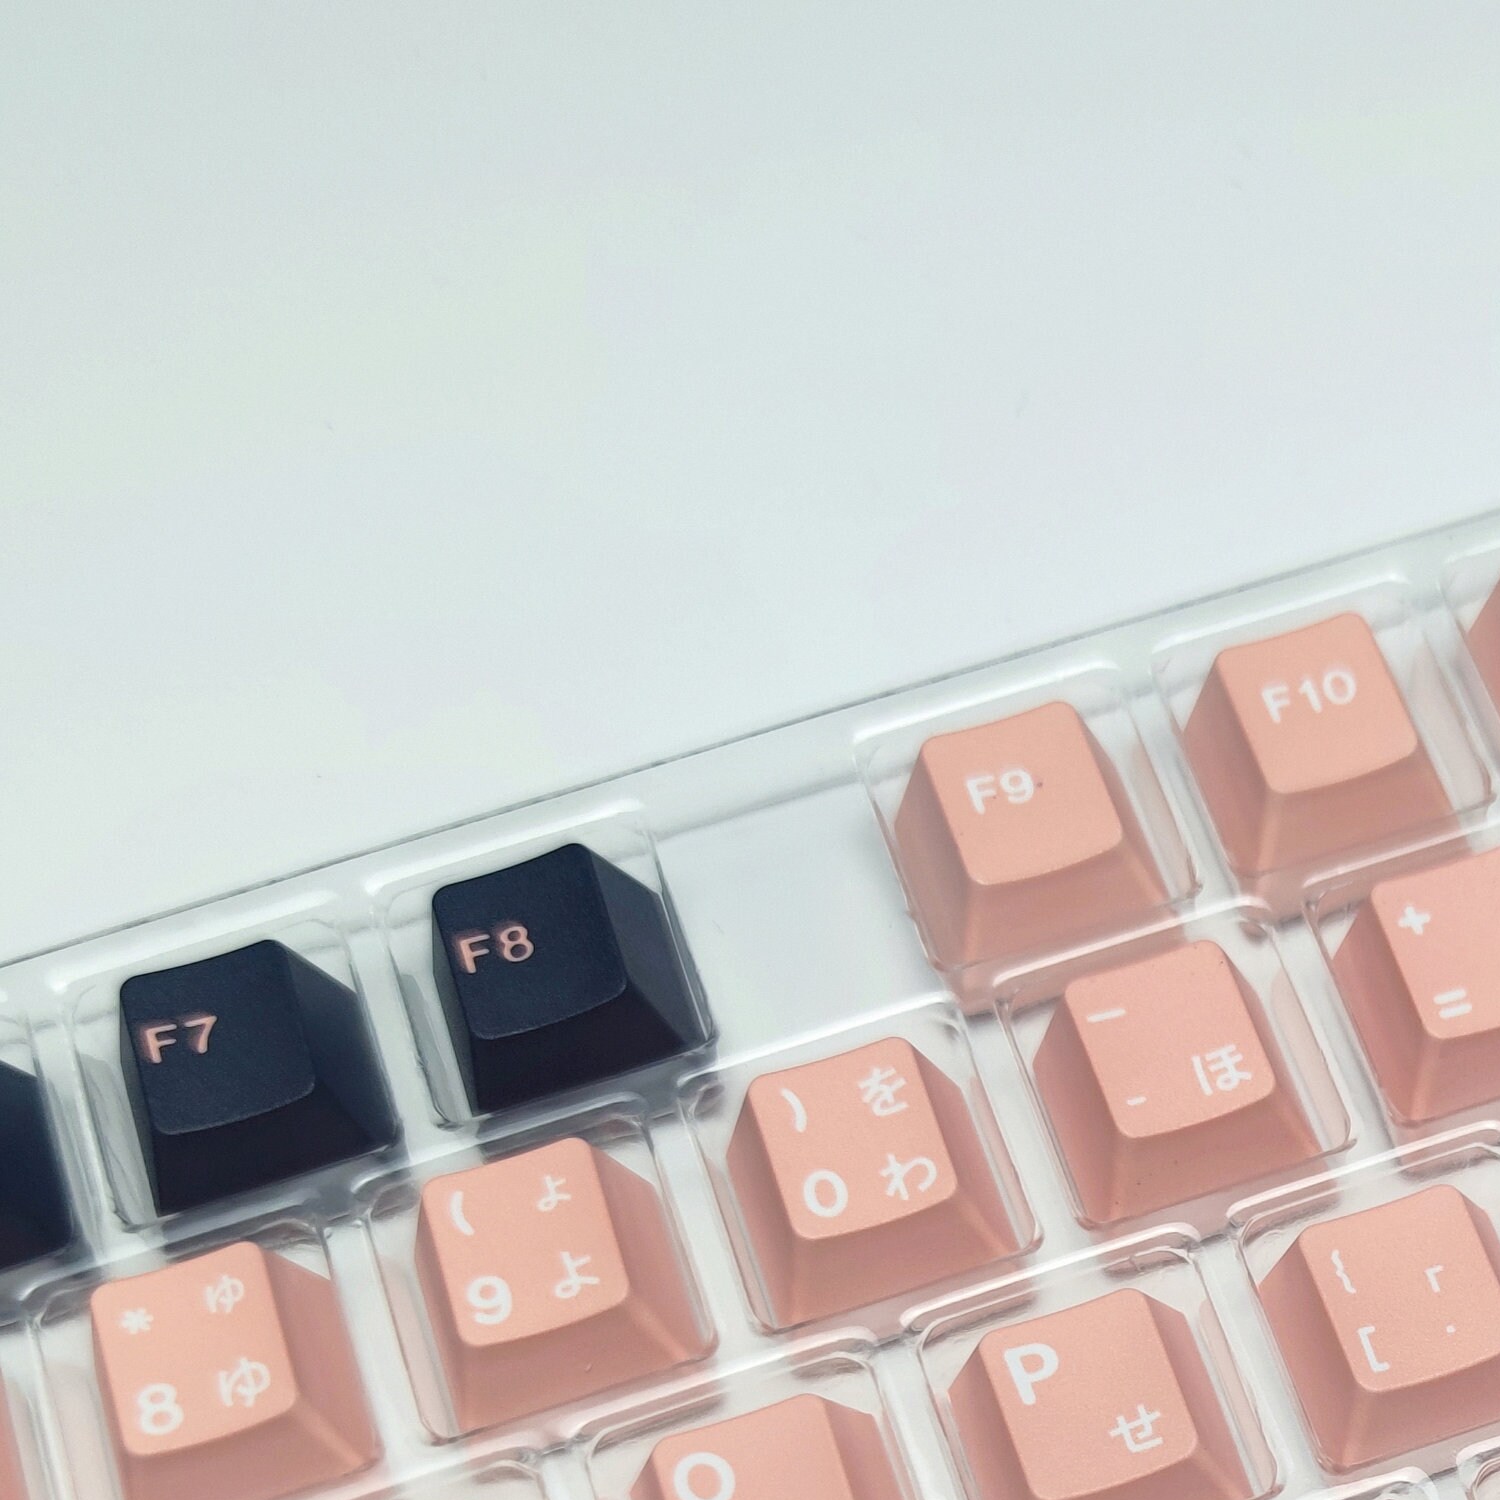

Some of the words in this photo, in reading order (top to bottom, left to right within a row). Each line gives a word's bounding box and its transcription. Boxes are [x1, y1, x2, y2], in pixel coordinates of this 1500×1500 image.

[1261, 669, 1358, 723] F10
[965, 768, 1034, 814] F9
[455, 924, 535, 975] F8
[144, 1014, 217, 1064] F7
[858, 1066, 908, 1117] を
[1191, 1044, 1252, 1097] ほ
[880, 1154, 937, 1201] わ
[466, 1275, 512, 1325] 9
[1003, 1342, 1059, 1405] P
[135, 1382, 184, 1436] 8
[1109, 1403, 1162, 1455] せ
